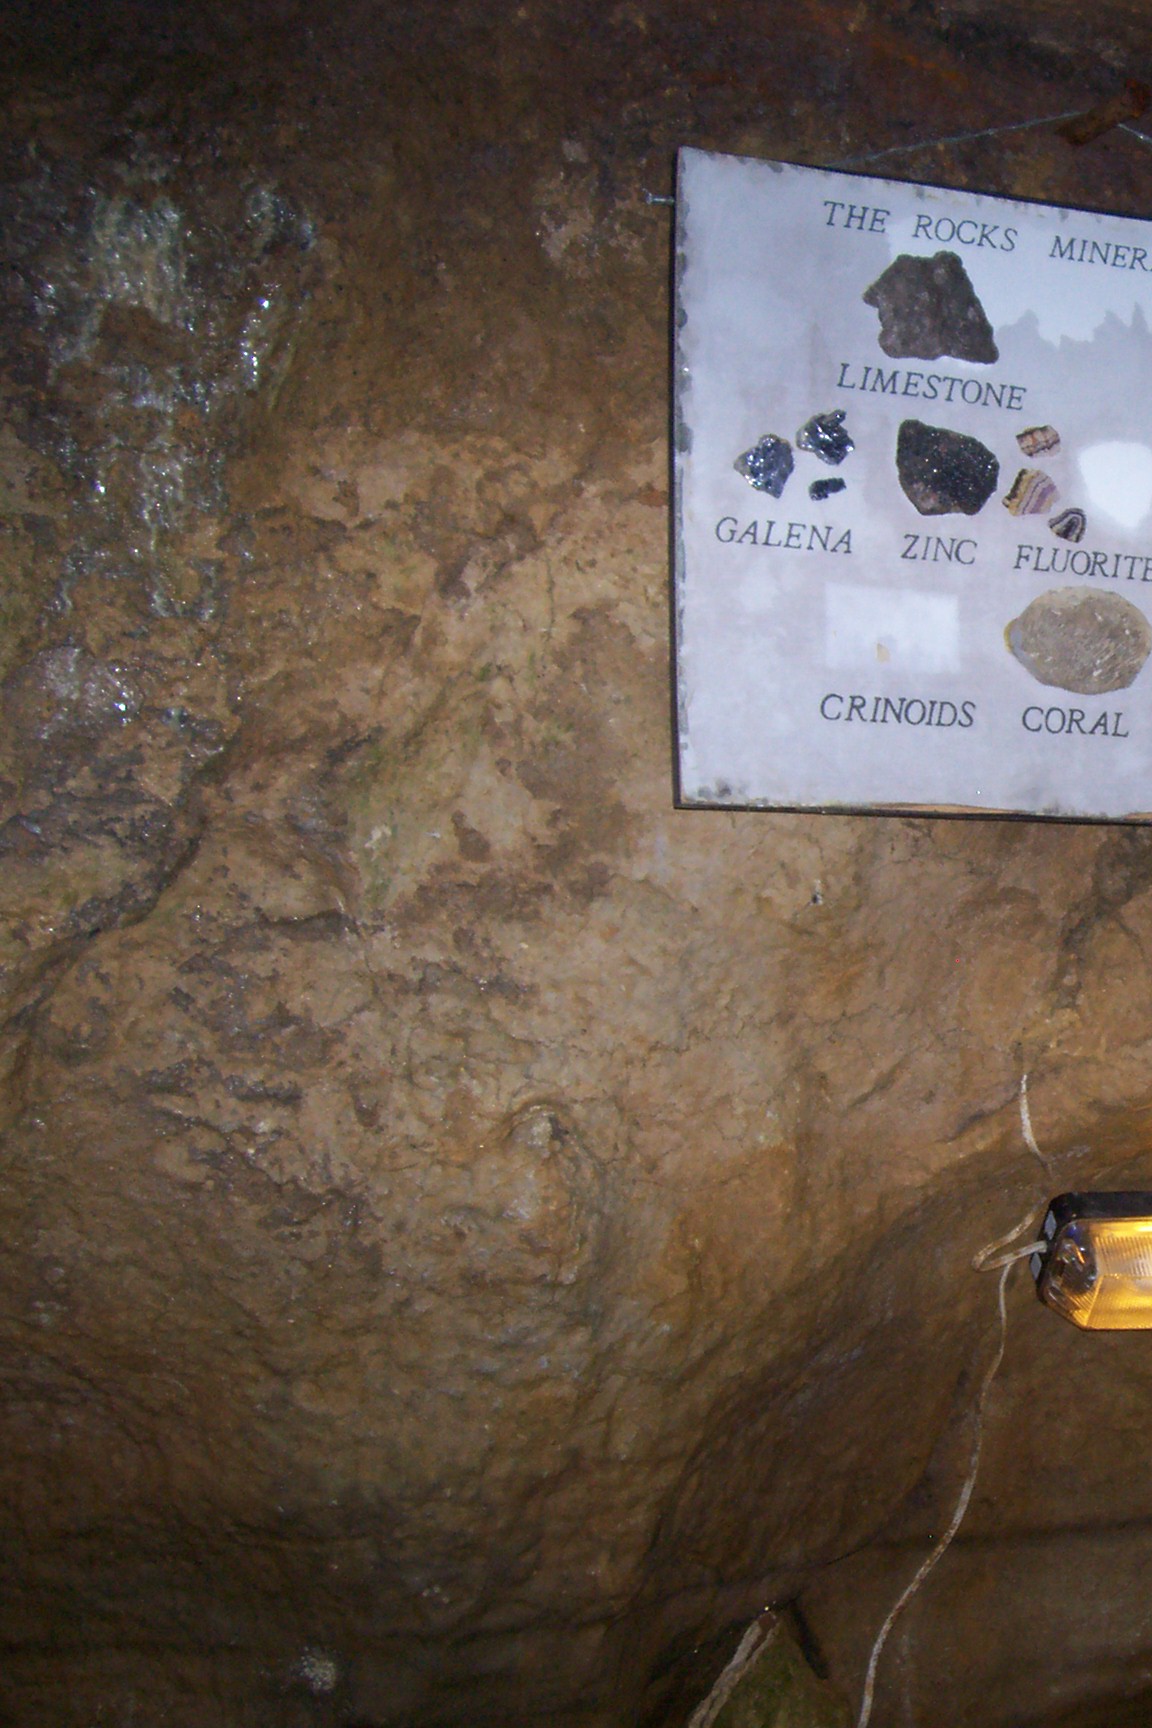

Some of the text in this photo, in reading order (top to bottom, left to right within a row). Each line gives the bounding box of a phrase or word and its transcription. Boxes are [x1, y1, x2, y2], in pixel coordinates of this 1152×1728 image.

[823, 200, 891, 234] THE
[911, 213, 1018, 252] ROCKS
[836, 362, 1028, 412] LIMESTONE
[715, 516, 852, 555] GALENA
[900, 533, 978, 565] ZINC
[820, 693, 976, 728] CRINOIDS
[1021, 706, 1129, 738] CORAL
